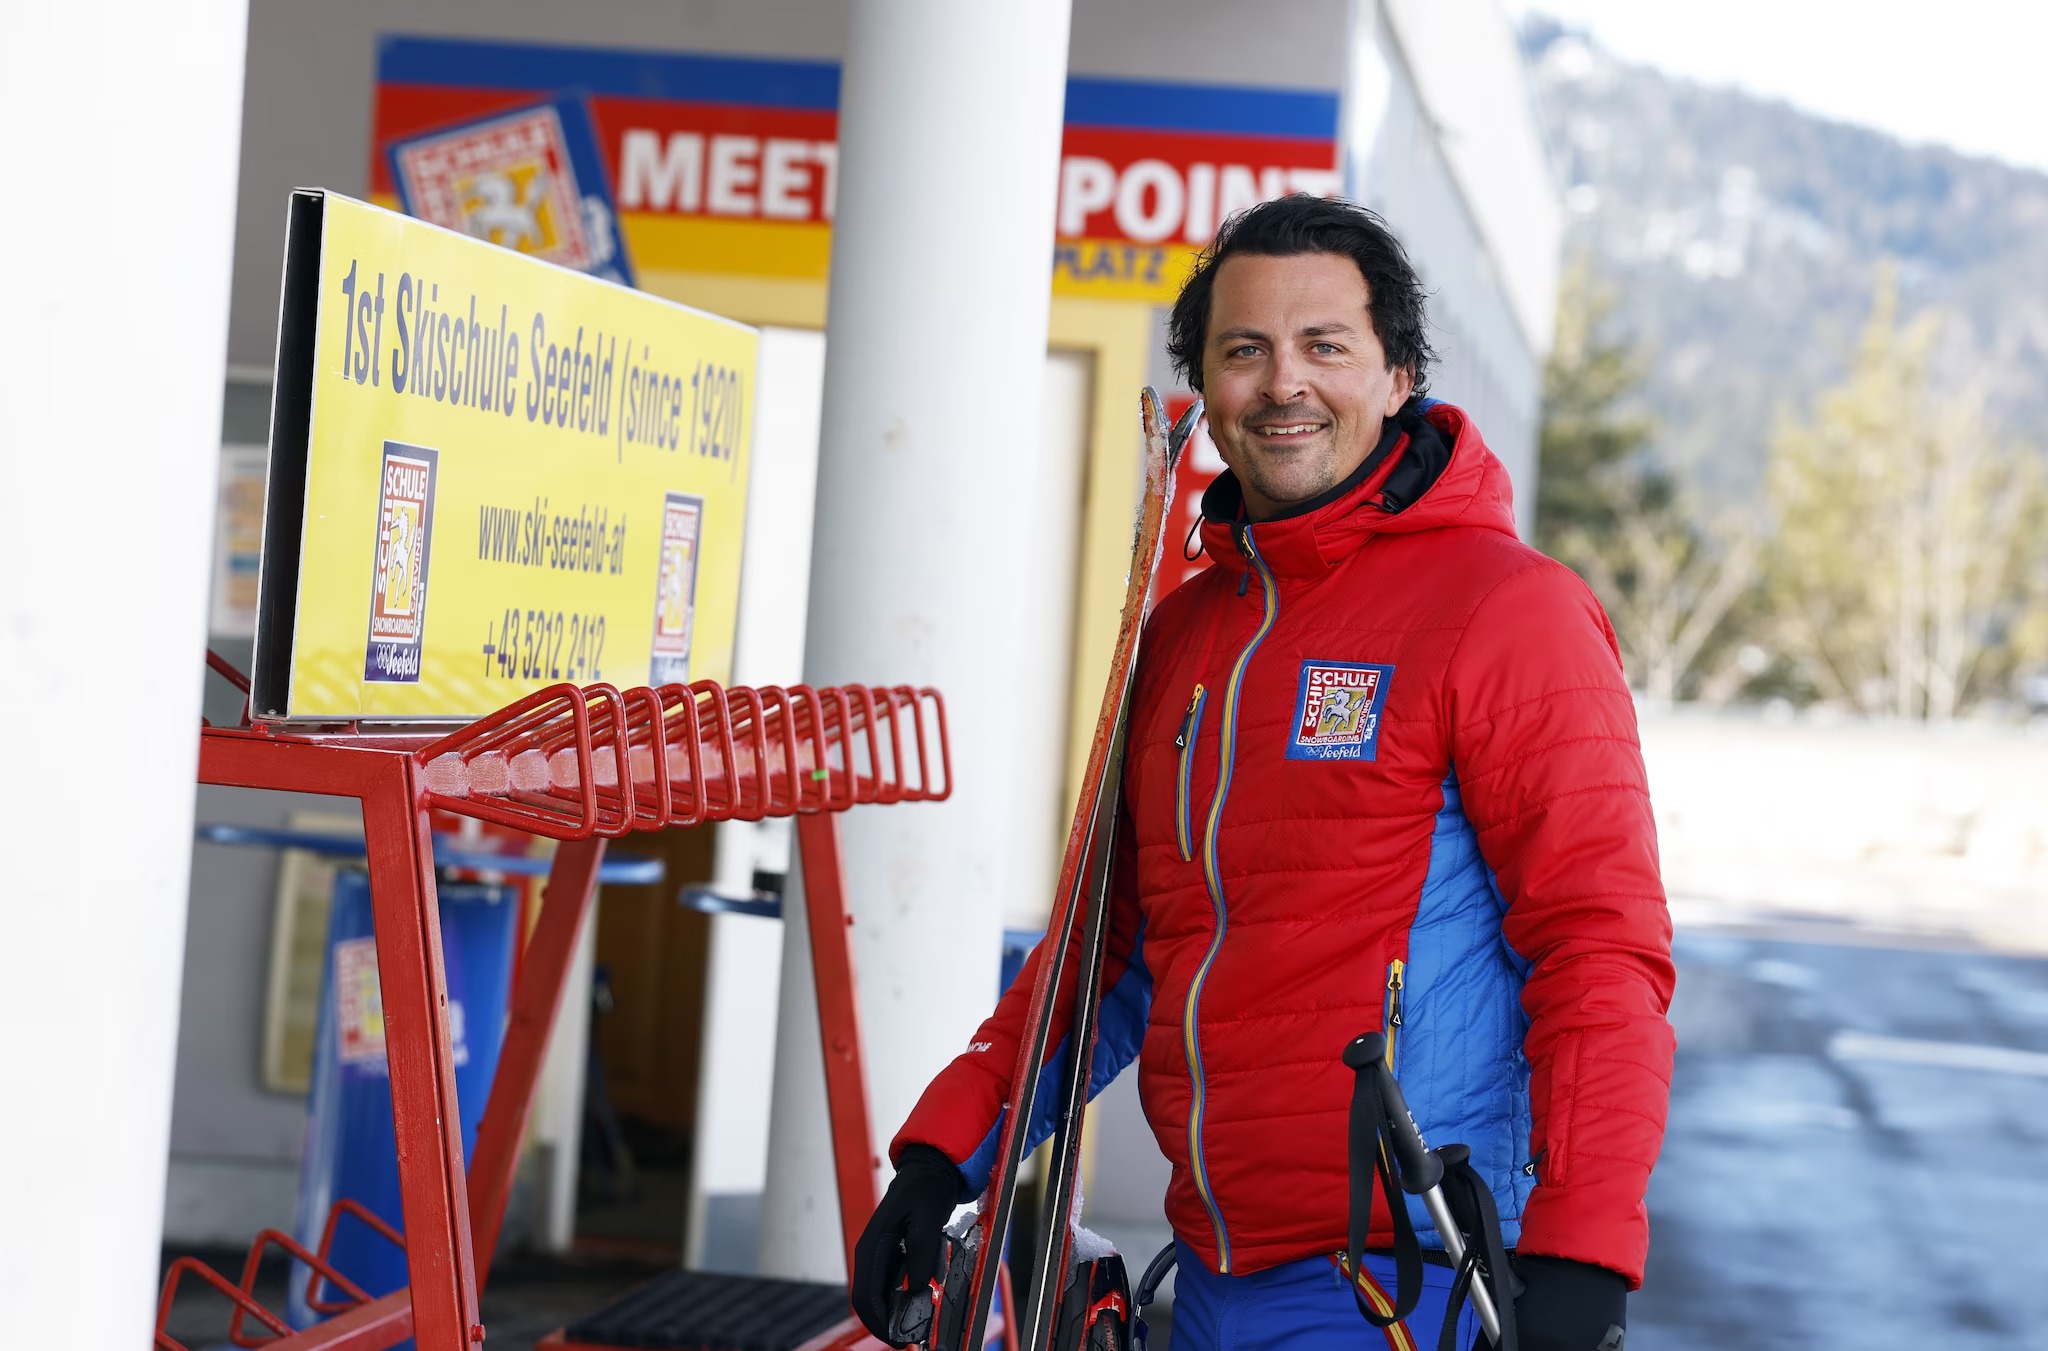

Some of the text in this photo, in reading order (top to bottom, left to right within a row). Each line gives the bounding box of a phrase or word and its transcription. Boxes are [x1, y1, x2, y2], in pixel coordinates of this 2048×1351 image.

[343, 259, 743, 486] 1st Skischule Seefeld (since 1920)
[386, 465, 427, 500] SCHULE
[377, 499, 393, 593] SCHI
[410, 526, 422, 613] CARVING
[374, 616, 414, 634] SNOWBOARDING
[483, 609, 520, 679] +43
[523, 610, 564, 679] 5212
[567, 612, 606, 680] 2412
[386, 643, 419, 680] Seefeld
[1311, 671, 1376, 687] SCHULE
[1305, 686, 1323, 728] SCHI
[1356, 699, 1371, 734] CARVING
[1300, 735, 1360, 744] SNOWBOARDING
[1320, 745, 1361, 760] Seefeld
[1406, 1110, 1430, 1154] LEKI
[1461, 1231, 1490, 1278] LKI
